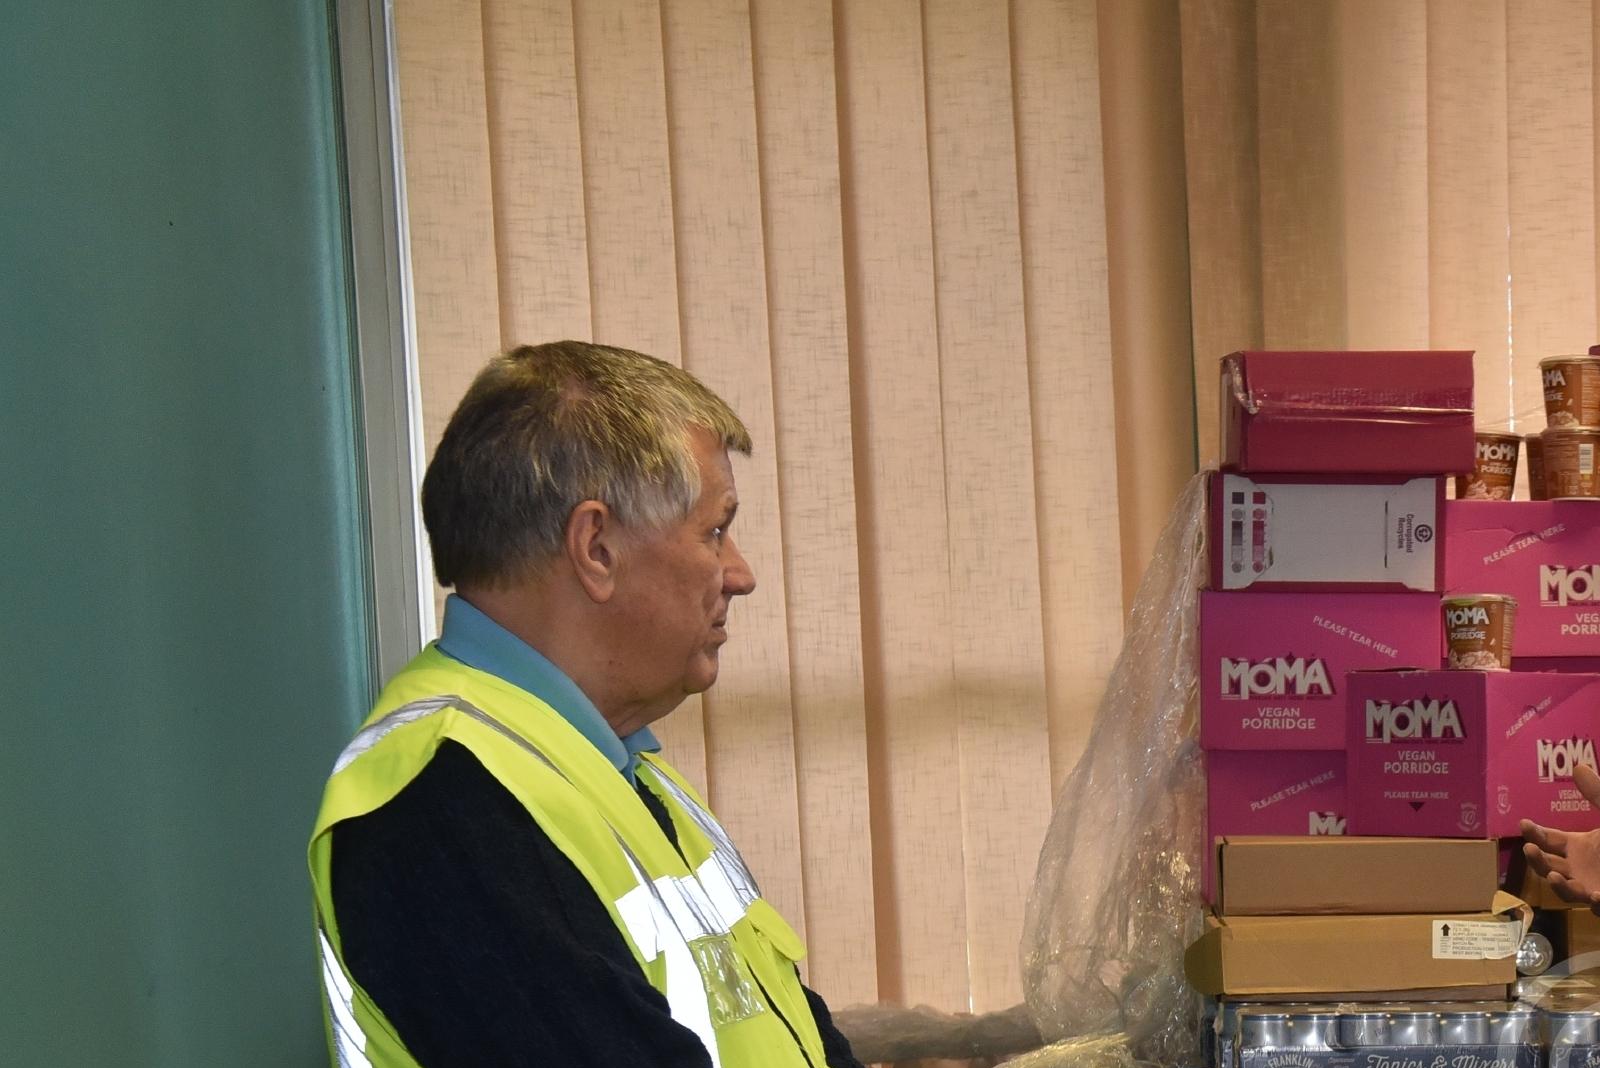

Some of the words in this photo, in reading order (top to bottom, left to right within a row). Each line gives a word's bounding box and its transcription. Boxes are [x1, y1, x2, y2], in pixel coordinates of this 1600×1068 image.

[1483, 544, 1516, 566] PLEASE
[1516, 532, 1542, 550] TEAR
[1540, 523, 1566, 541] HERE
[1313, 615, 1348, 637] PLEASE
[1348, 630, 1373, 648] TEAR
[1370, 641, 1398, 659] HERE
[1220, 656, 1334, 700] MOMA
[1241, 718, 1316, 730] PORRIDGE
[1257, 707, 1300, 718] VEGAN
[1365, 699, 1466, 744] MOMA
[1384, 762, 1449, 774] PORRIDGE
[1398, 751, 1435, 761] VEGAN
[1537, 739, 1599, 782] MOMA
[1250, 790, 1285, 812] PLEASE
[1284, 780, 1309, 799] TEAR
[1307, 770, 1336, 789] HERE
[1384, 791, 1411, 800] PLEASE
[1411, 791, 1427, 800] TEAR
[1427, 791, 1449, 800] HERE
[1551, 800, 1591, 812] PORRIDGE
